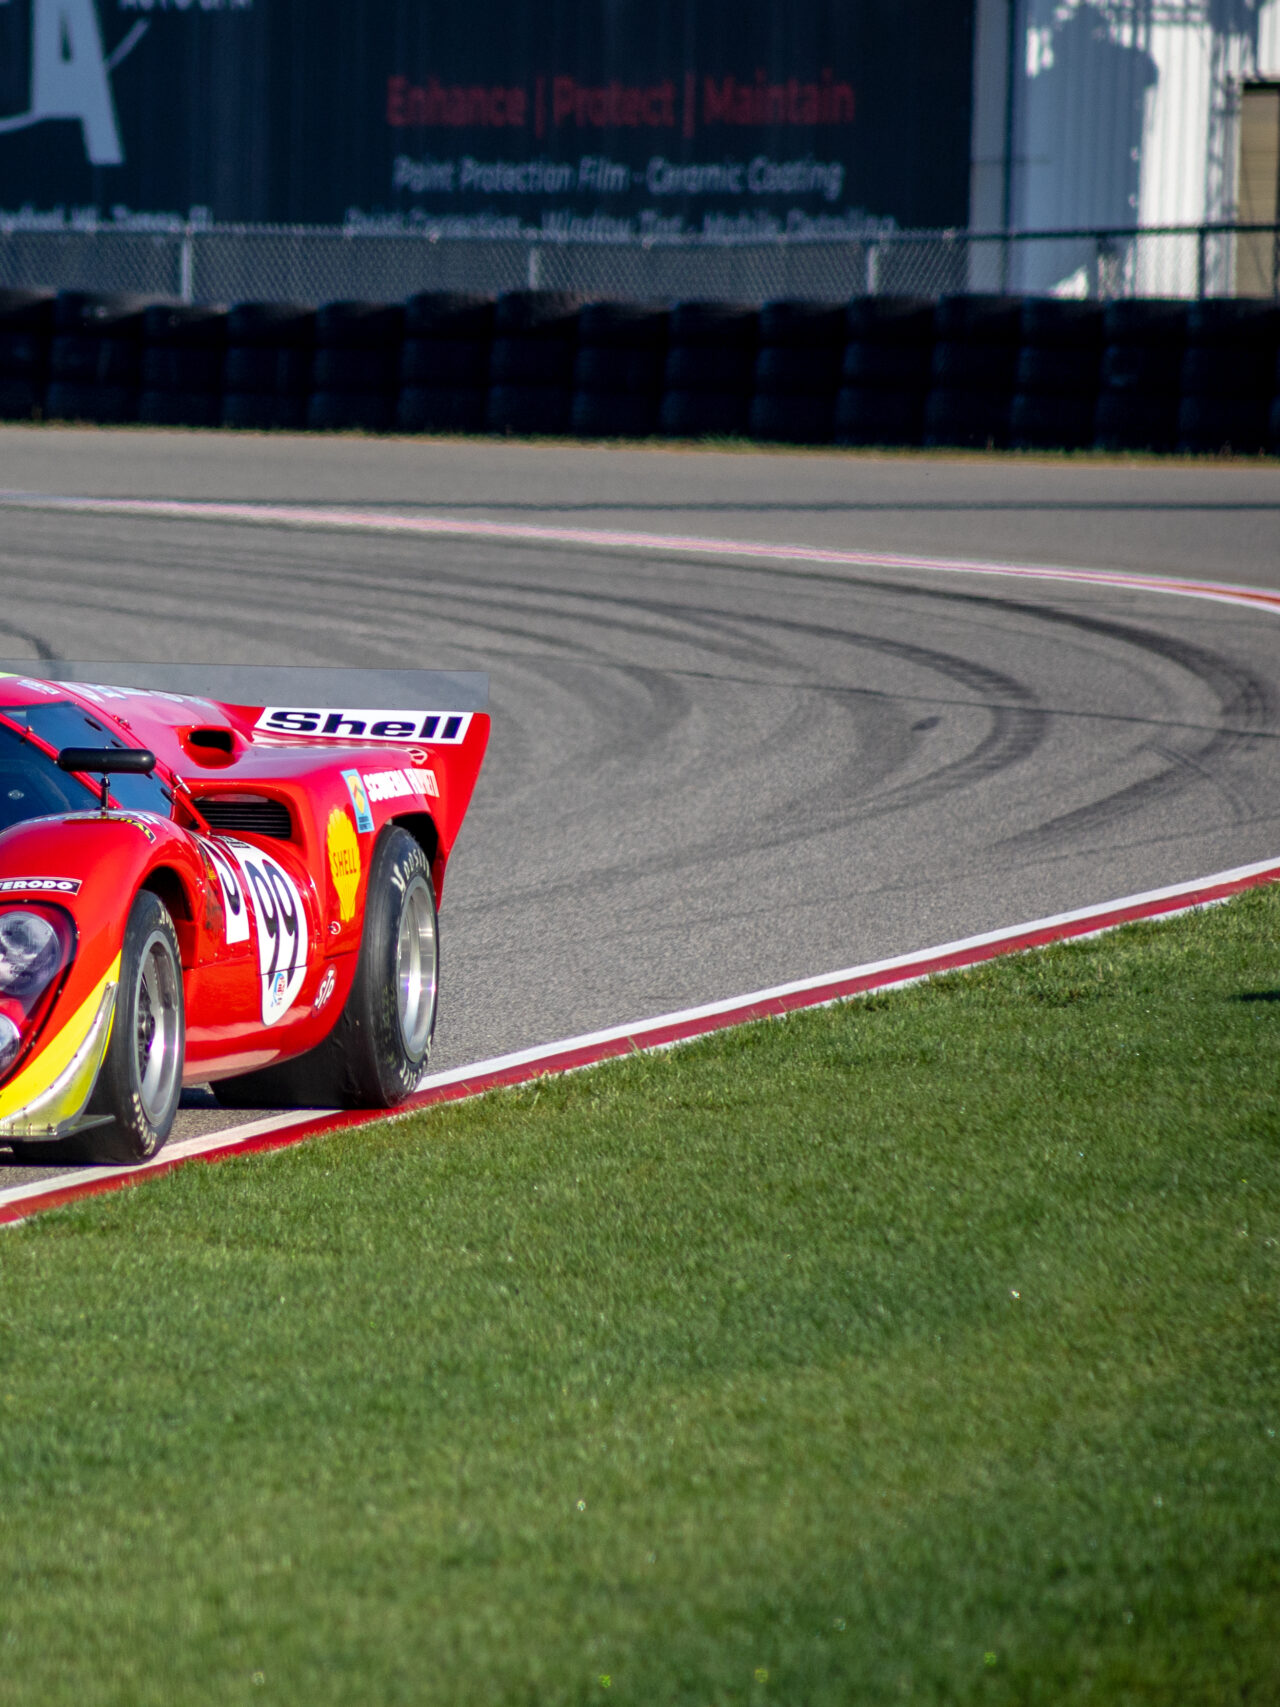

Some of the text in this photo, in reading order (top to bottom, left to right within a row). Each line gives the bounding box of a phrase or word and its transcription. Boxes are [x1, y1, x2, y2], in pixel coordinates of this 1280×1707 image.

[387, 75, 527, 127] Enhance
[552, 75, 674, 127] Protect
[704, 68, 855, 126] Maintain
[461, 154, 573, 192] Protection
[647, 155, 744, 194] Ceramic
[748, 152, 845, 201] Coating
[266, 711, 464, 740] Shell
[332, 848, 358, 877] SHELL
[244, 858, 299, 992] 99
